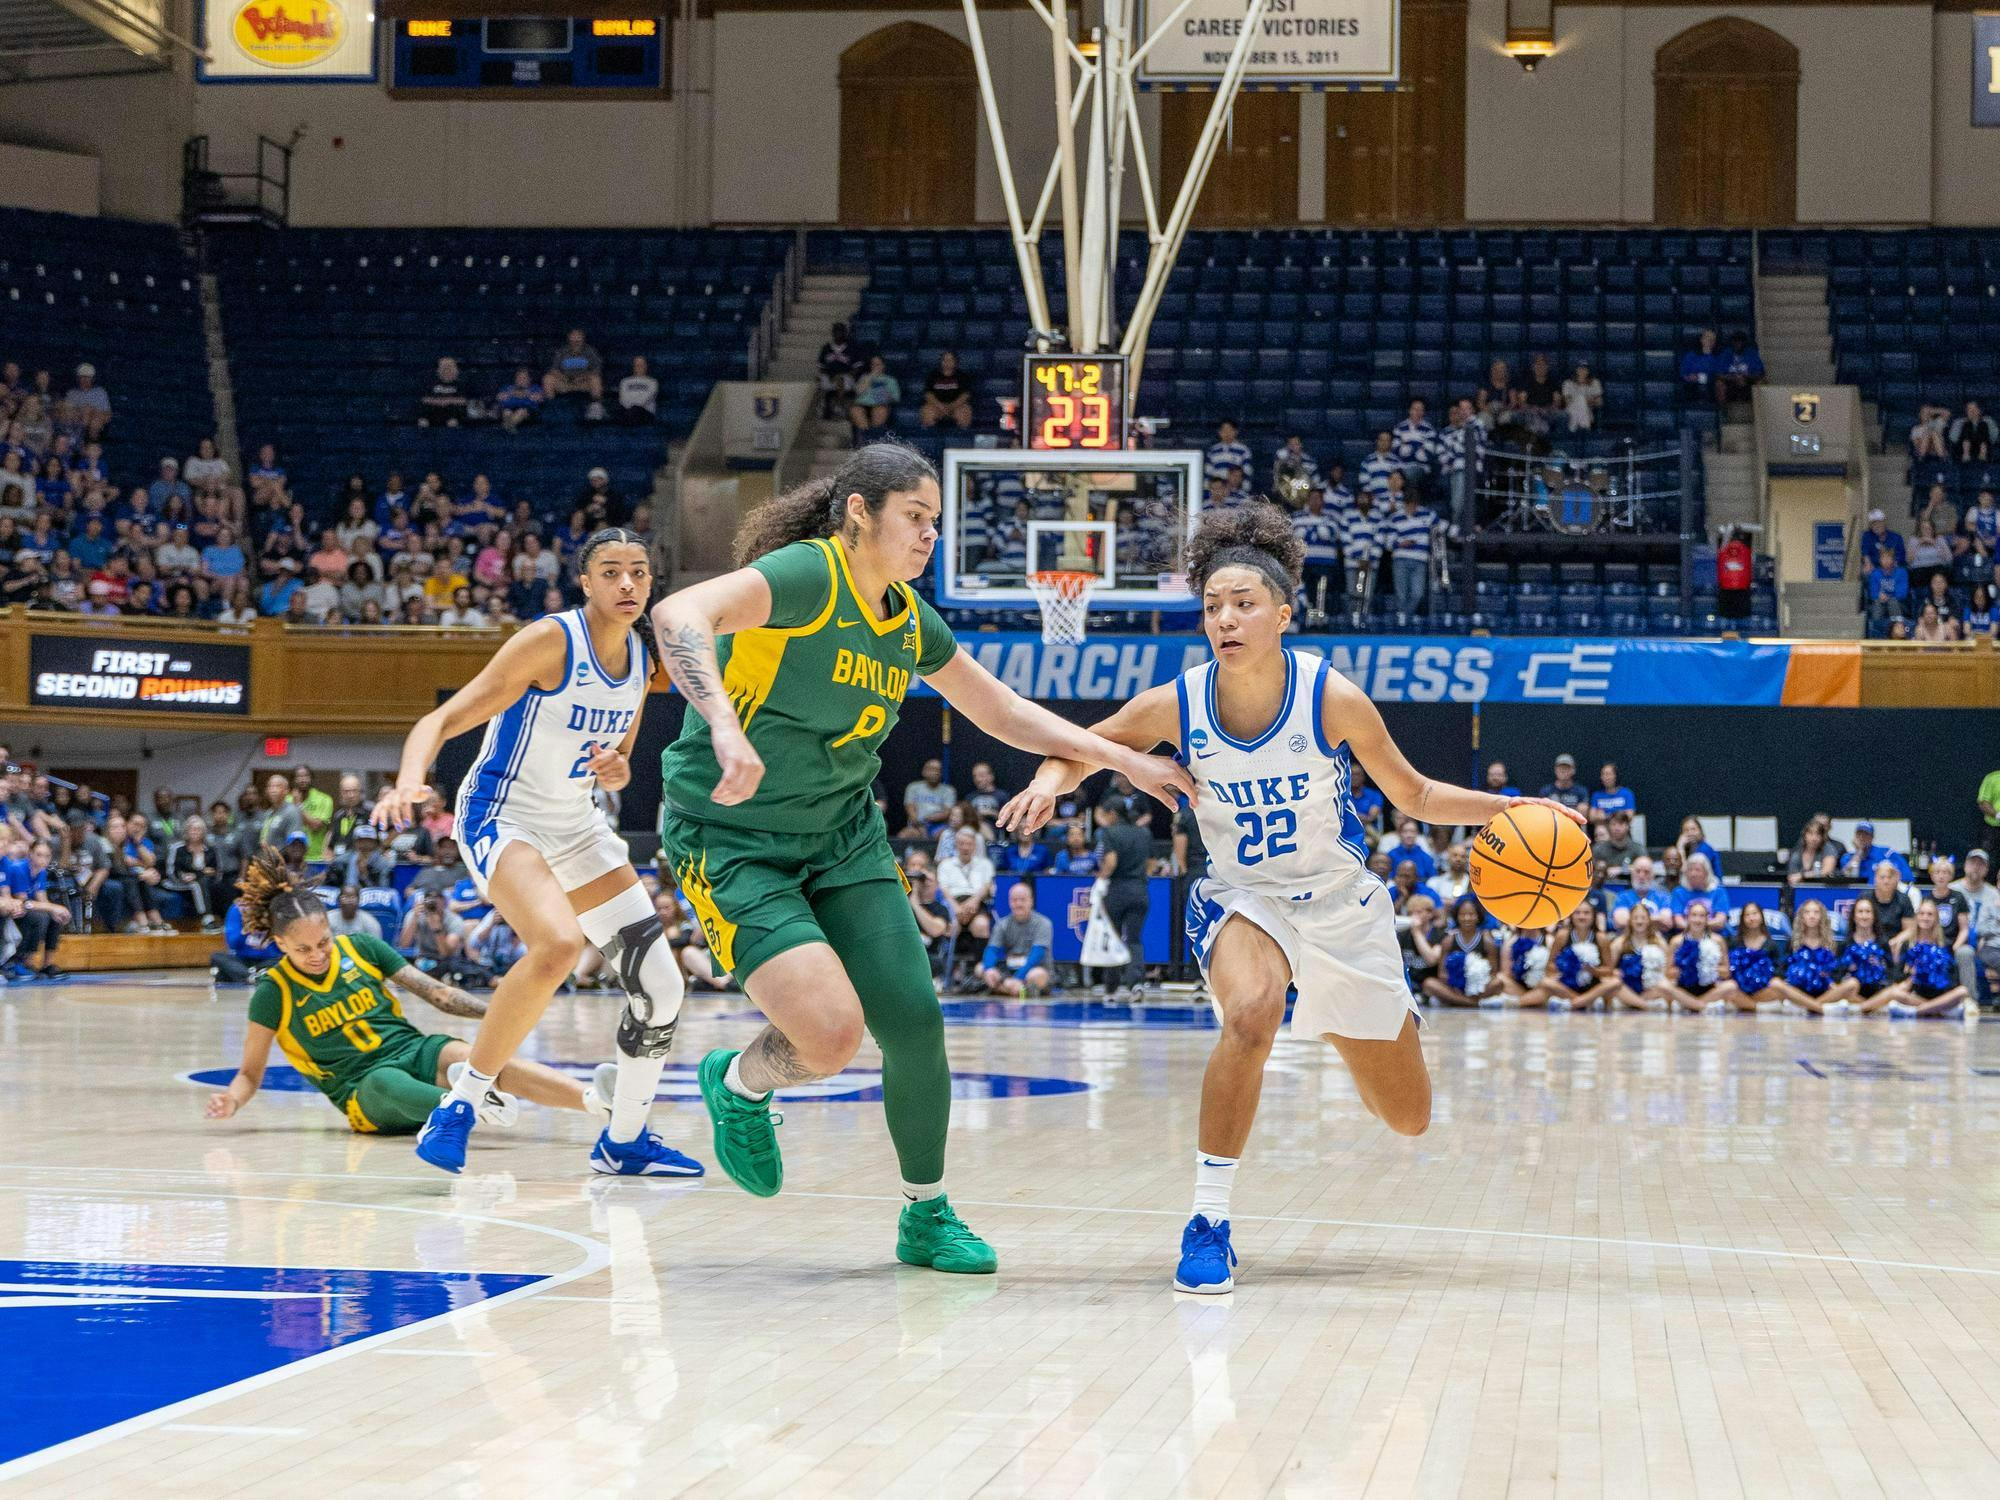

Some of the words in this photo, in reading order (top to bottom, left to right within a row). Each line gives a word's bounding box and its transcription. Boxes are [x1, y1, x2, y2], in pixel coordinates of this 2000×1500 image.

[407, 20, 452, 37] DUKE
[1184, 19, 1255, 36] CAREE
[1263, 19, 1360, 36] VICTORIES
[1307, 51, 1339, 64] 2011
[1036, 364, 1101, 395] 47.2
[1044, 396, 1109, 447] 23
[92, 650, 170, 675] FIRST
[832, 648, 909, 703] BAYLOR
[36, 673, 139, 699] SECOND
[140, 677, 243, 705] ROUNDS
[567, 703, 634, 734] DUKE
[1208, 772, 1310, 808] DUKE
[1235, 808, 1298, 867] 22
[303, 986, 379, 1038] BAYLOR
[341, 1019, 383, 1053] 0
